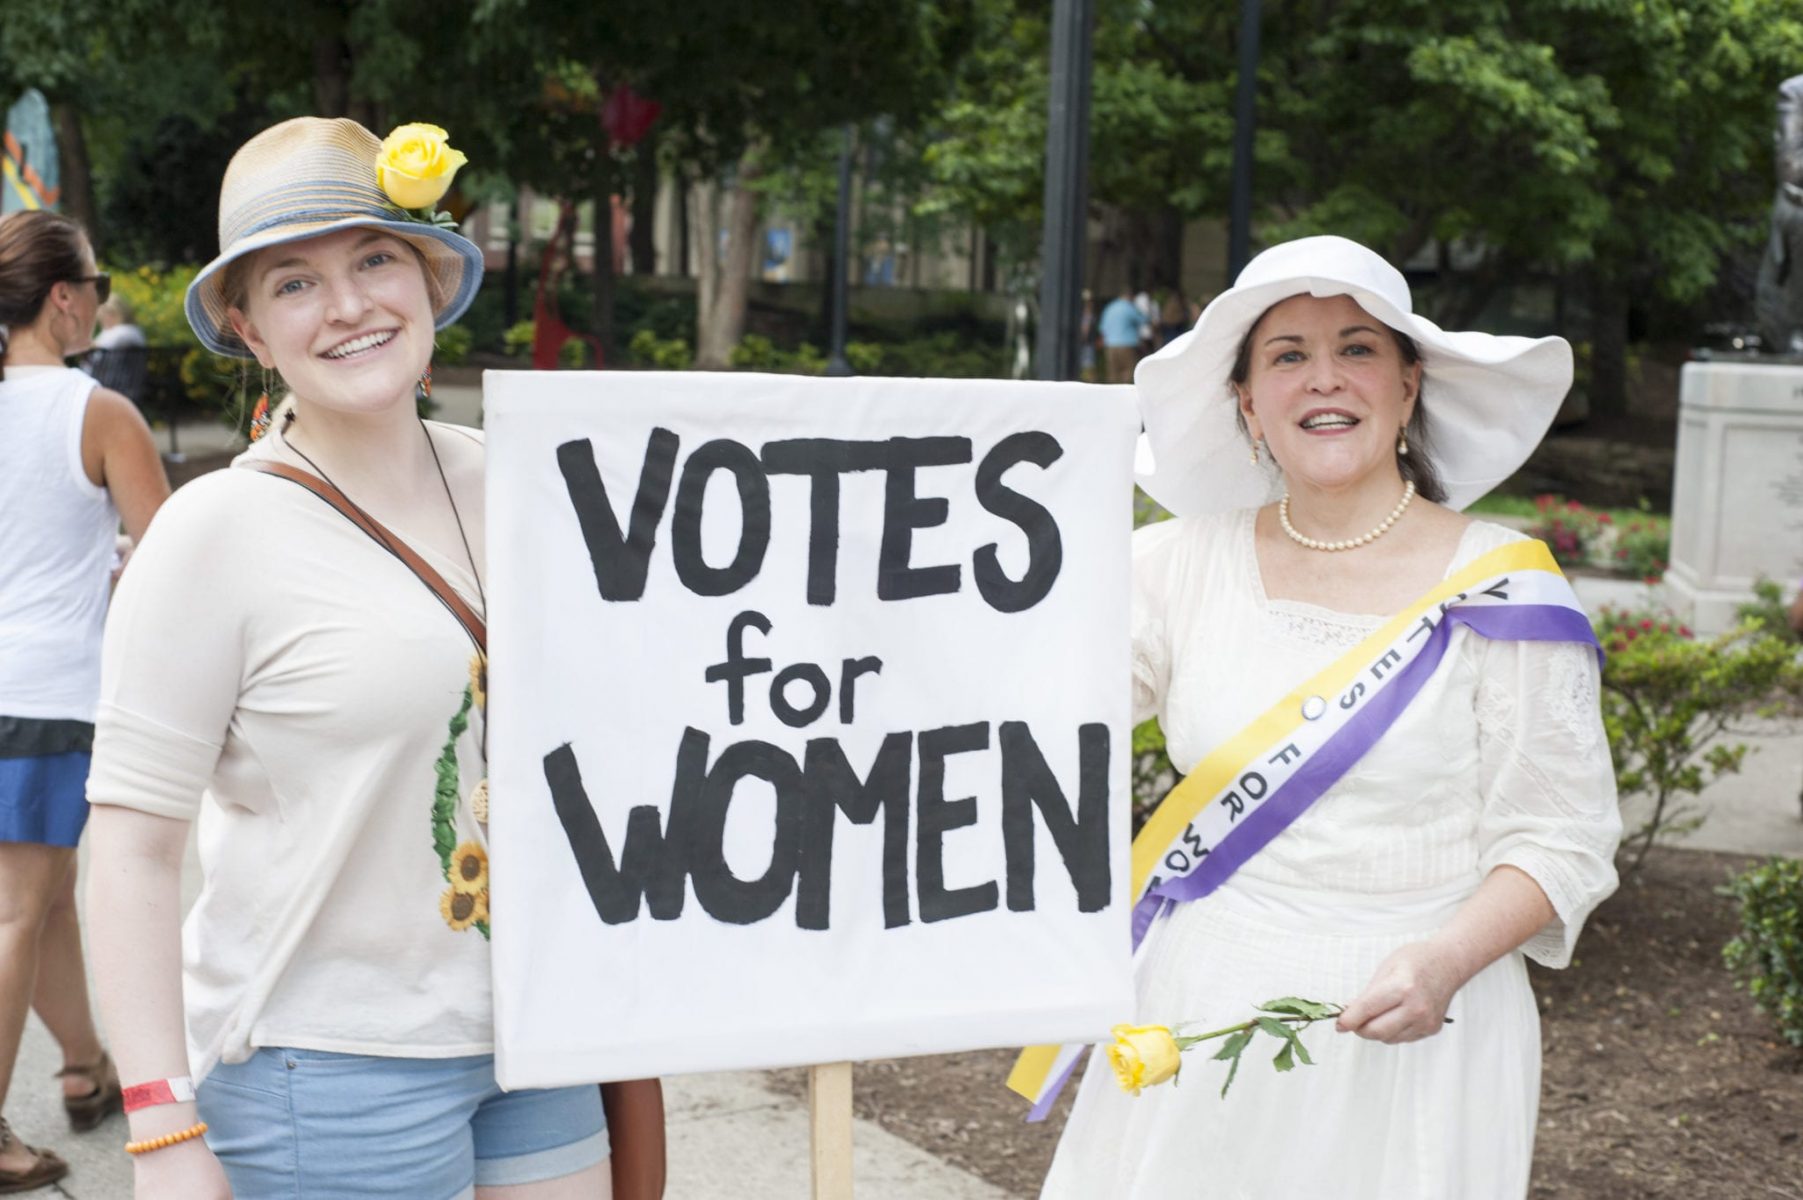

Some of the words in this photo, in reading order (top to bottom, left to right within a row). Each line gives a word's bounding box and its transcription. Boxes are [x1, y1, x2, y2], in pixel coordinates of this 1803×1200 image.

[556, 427, 1064, 613] VOTES
[705, 610, 883, 728] for
[543, 721, 1112, 930] WOMEN
[1220, 742, 1301, 823] FOR
